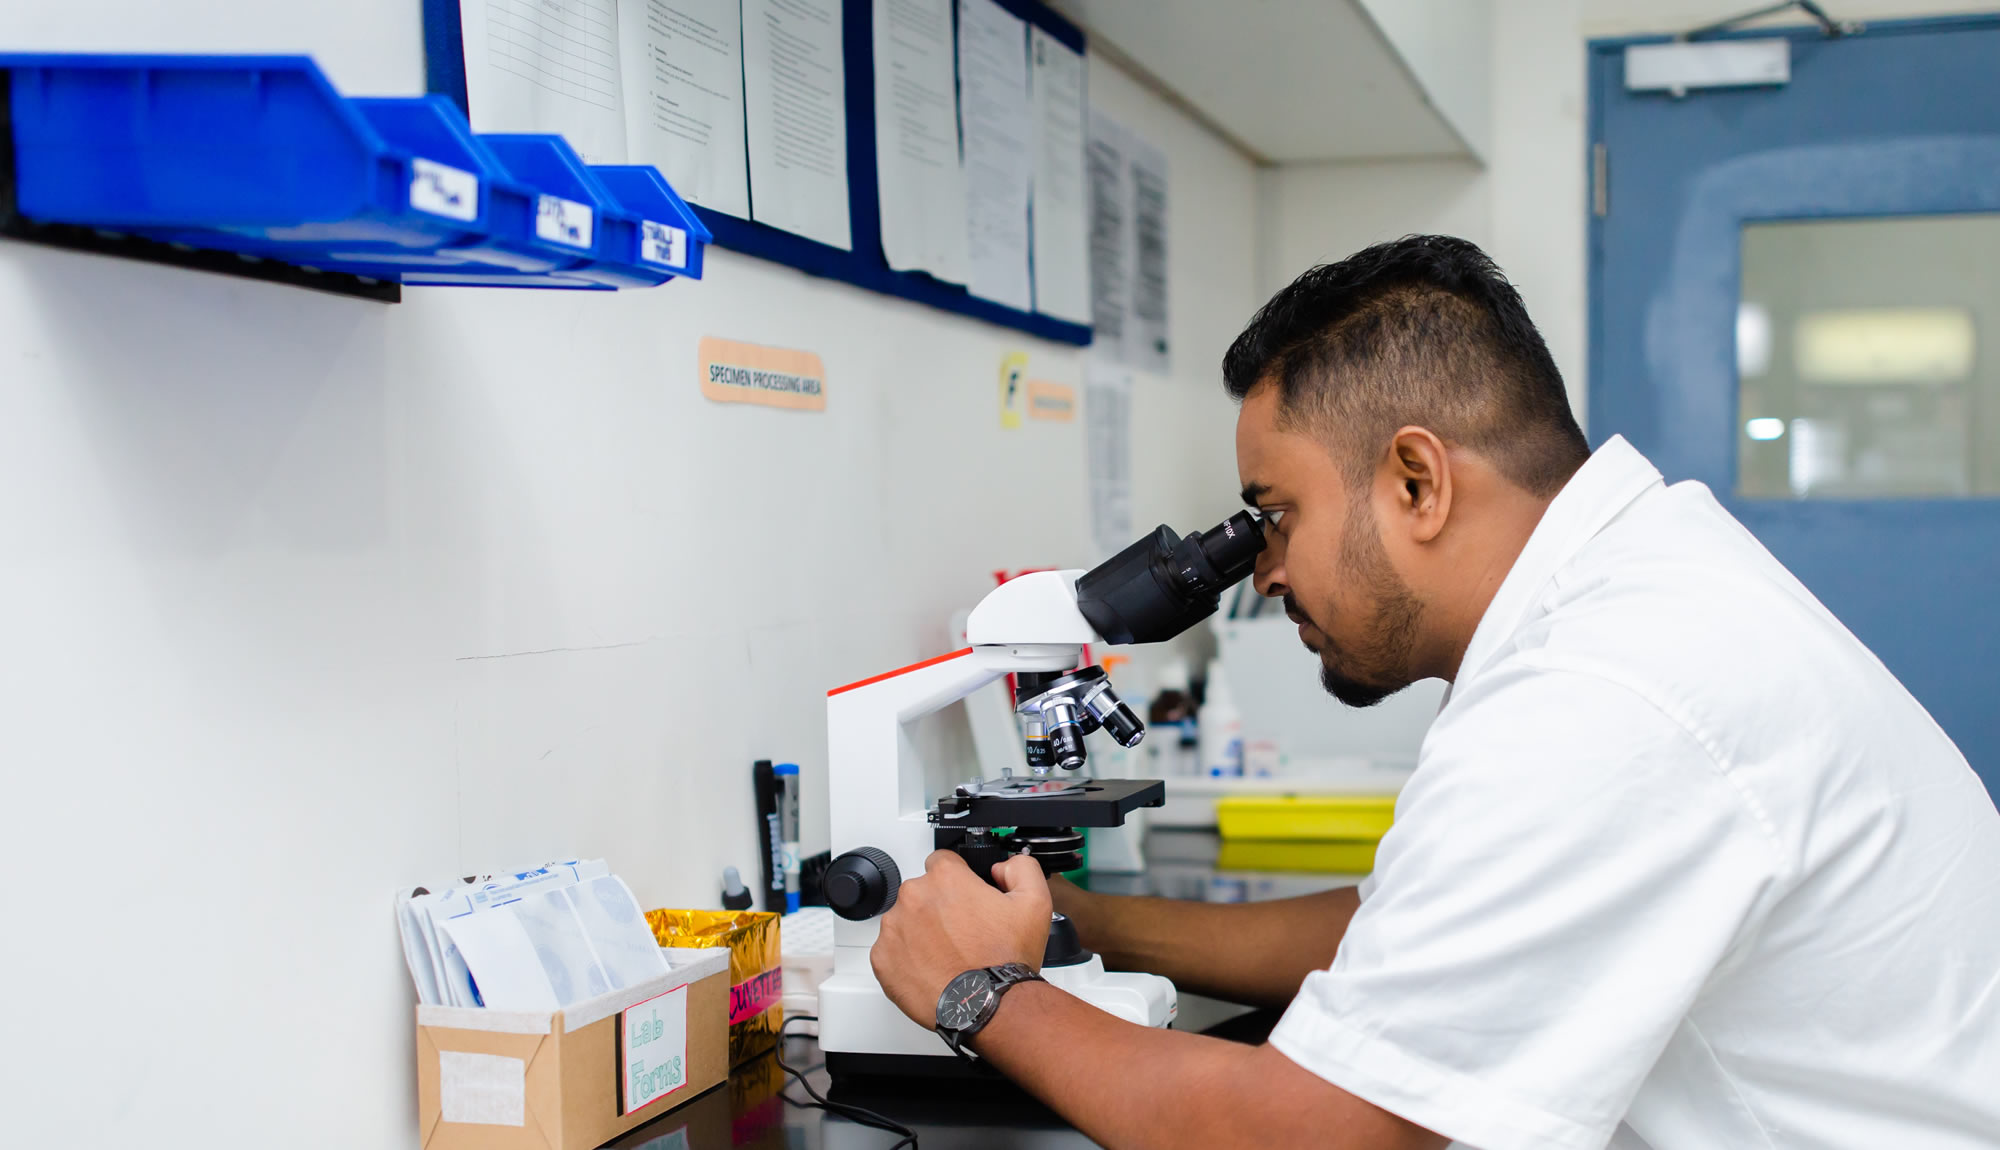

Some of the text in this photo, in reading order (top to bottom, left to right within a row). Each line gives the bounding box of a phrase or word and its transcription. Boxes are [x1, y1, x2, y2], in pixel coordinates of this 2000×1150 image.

[709, 364, 821, 395] SPECIMEN PROCESSING AREA
[631, 1009, 664, 1049] Lab
[631, 1055, 682, 1105] Forms
